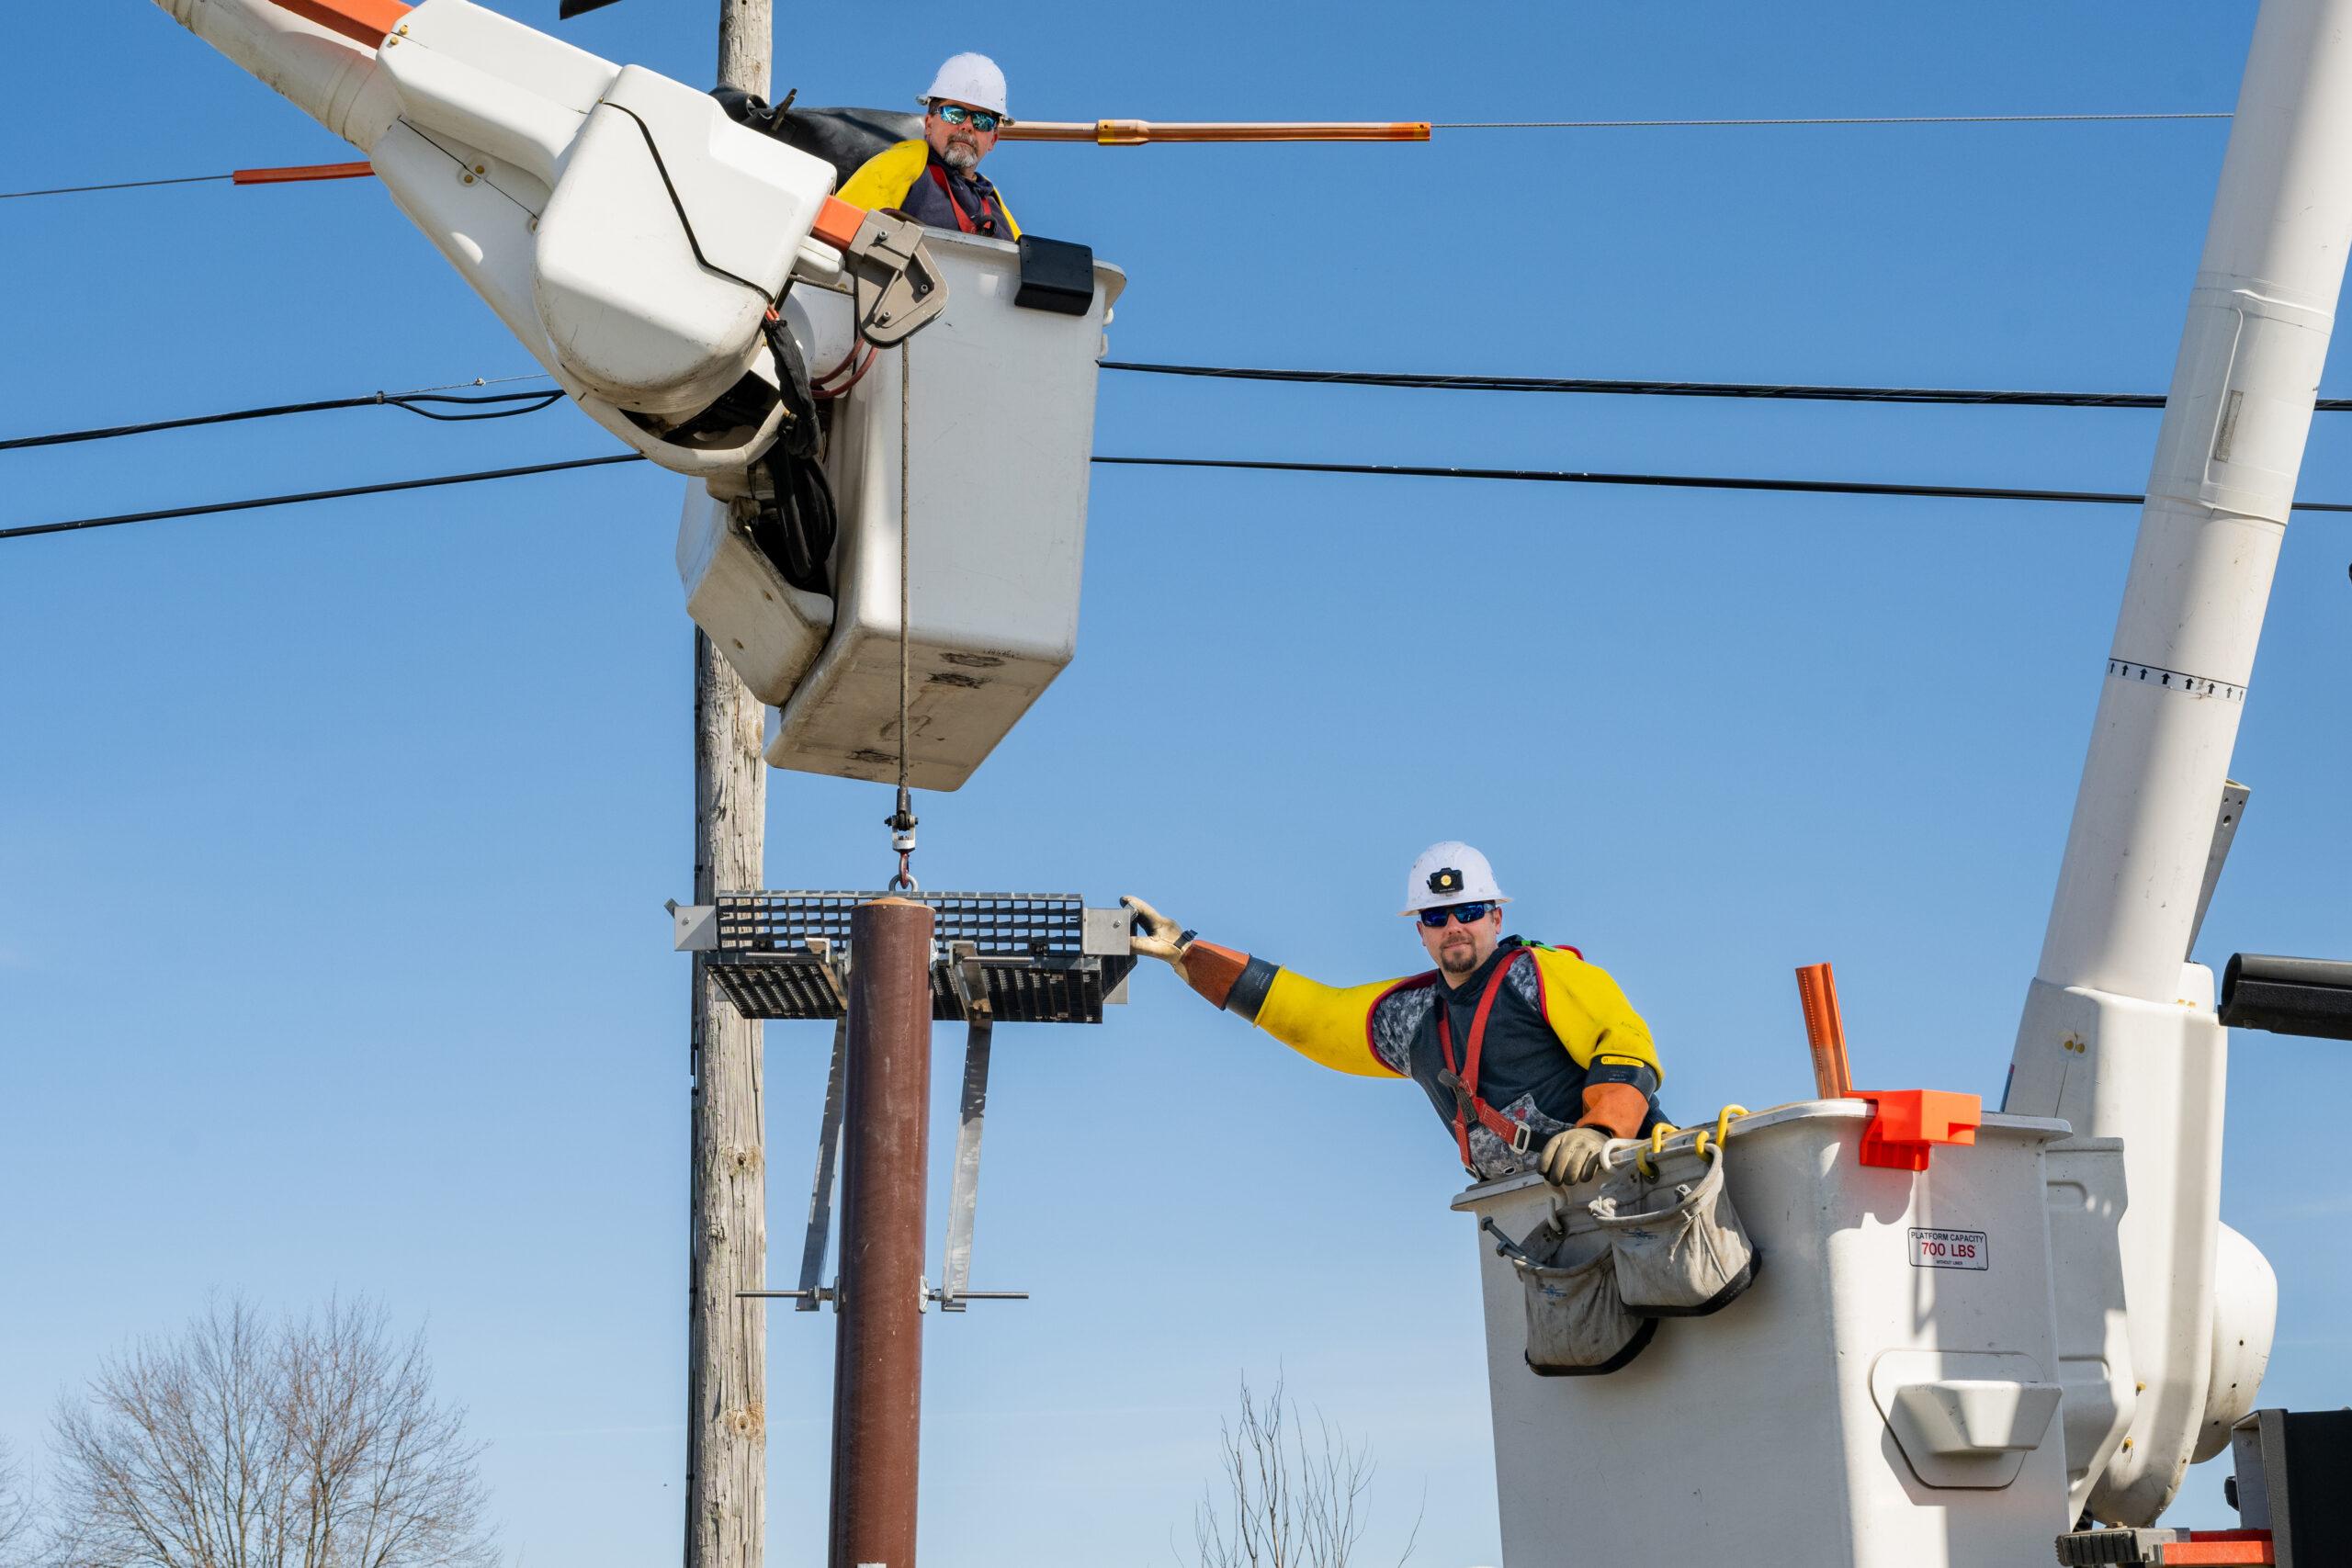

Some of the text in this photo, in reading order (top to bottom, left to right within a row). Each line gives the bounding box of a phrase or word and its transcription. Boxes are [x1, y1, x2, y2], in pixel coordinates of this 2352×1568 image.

[1911, 1232, 1984, 1243] PLATFORM CAPACITY
[1921, 1242, 1975, 1258] 700 LBS
